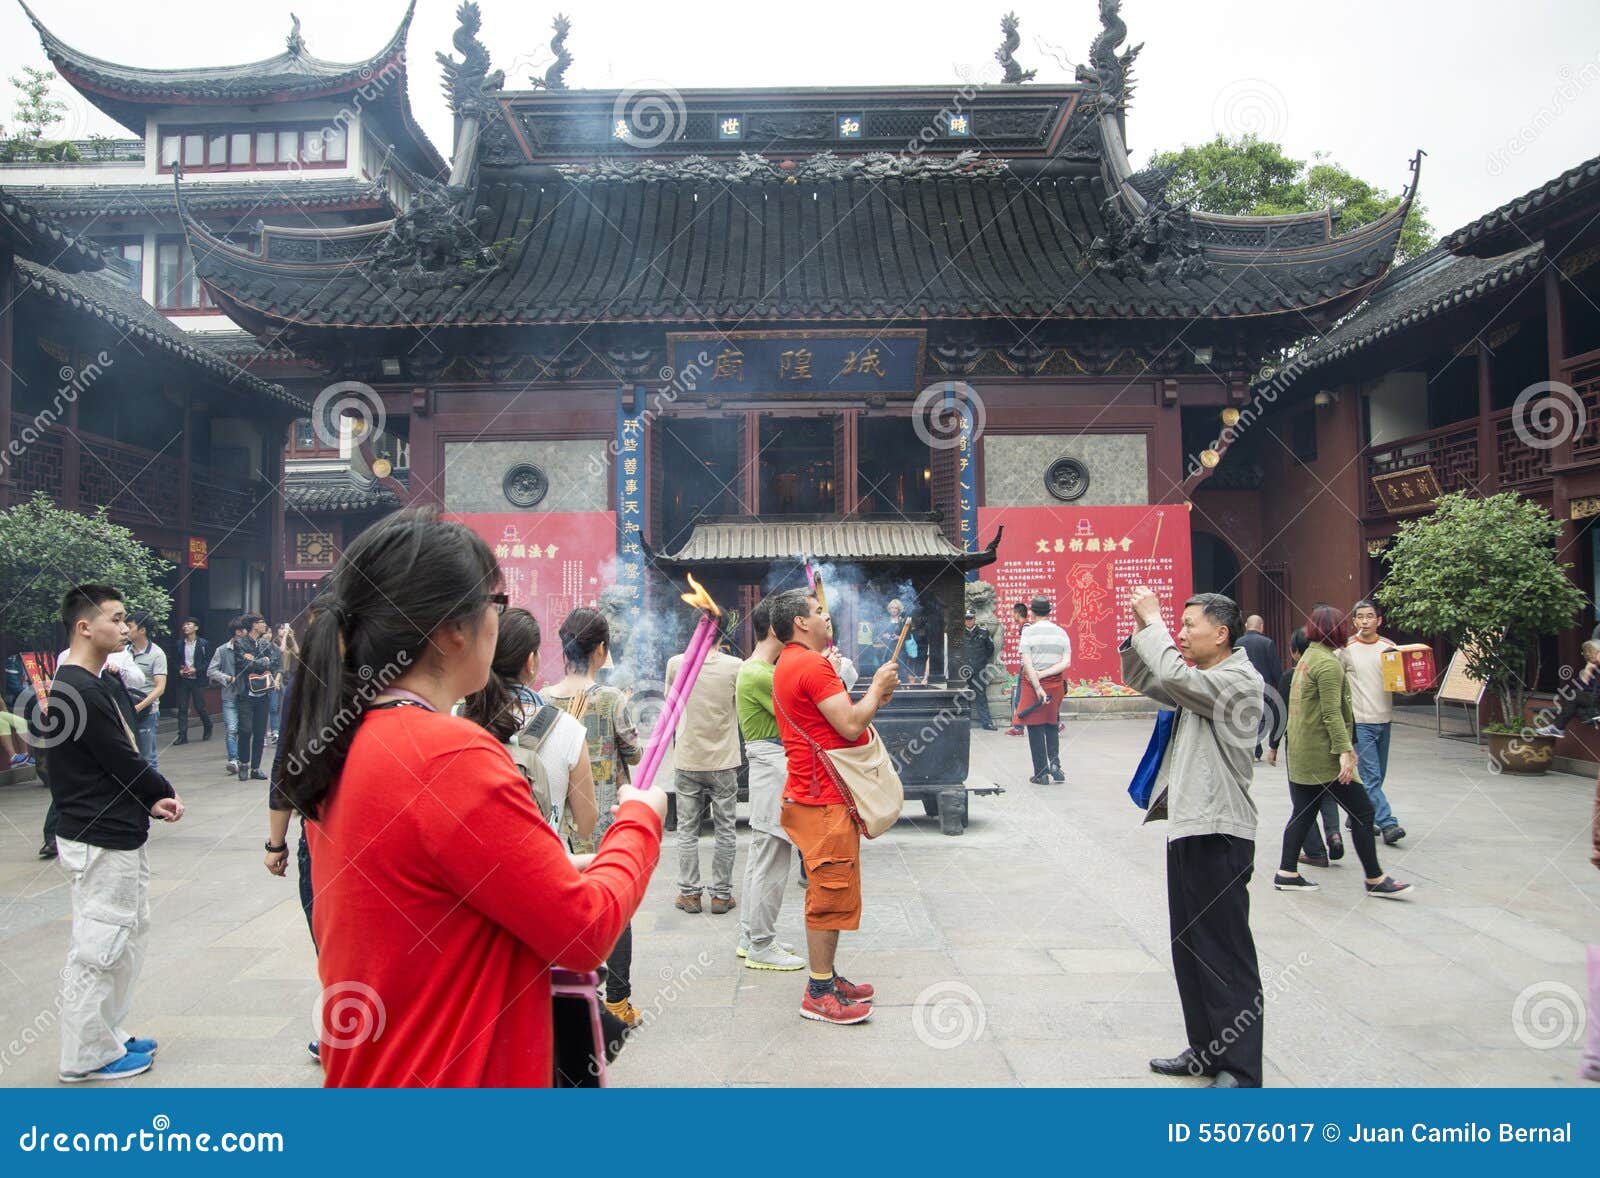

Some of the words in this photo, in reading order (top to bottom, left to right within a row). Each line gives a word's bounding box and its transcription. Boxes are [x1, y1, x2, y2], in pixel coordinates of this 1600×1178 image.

[721, 119, 739, 135] 世
[841, 118, 860, 135] 和
[1035, 536, 1134, 553] 文昌祈願法會
